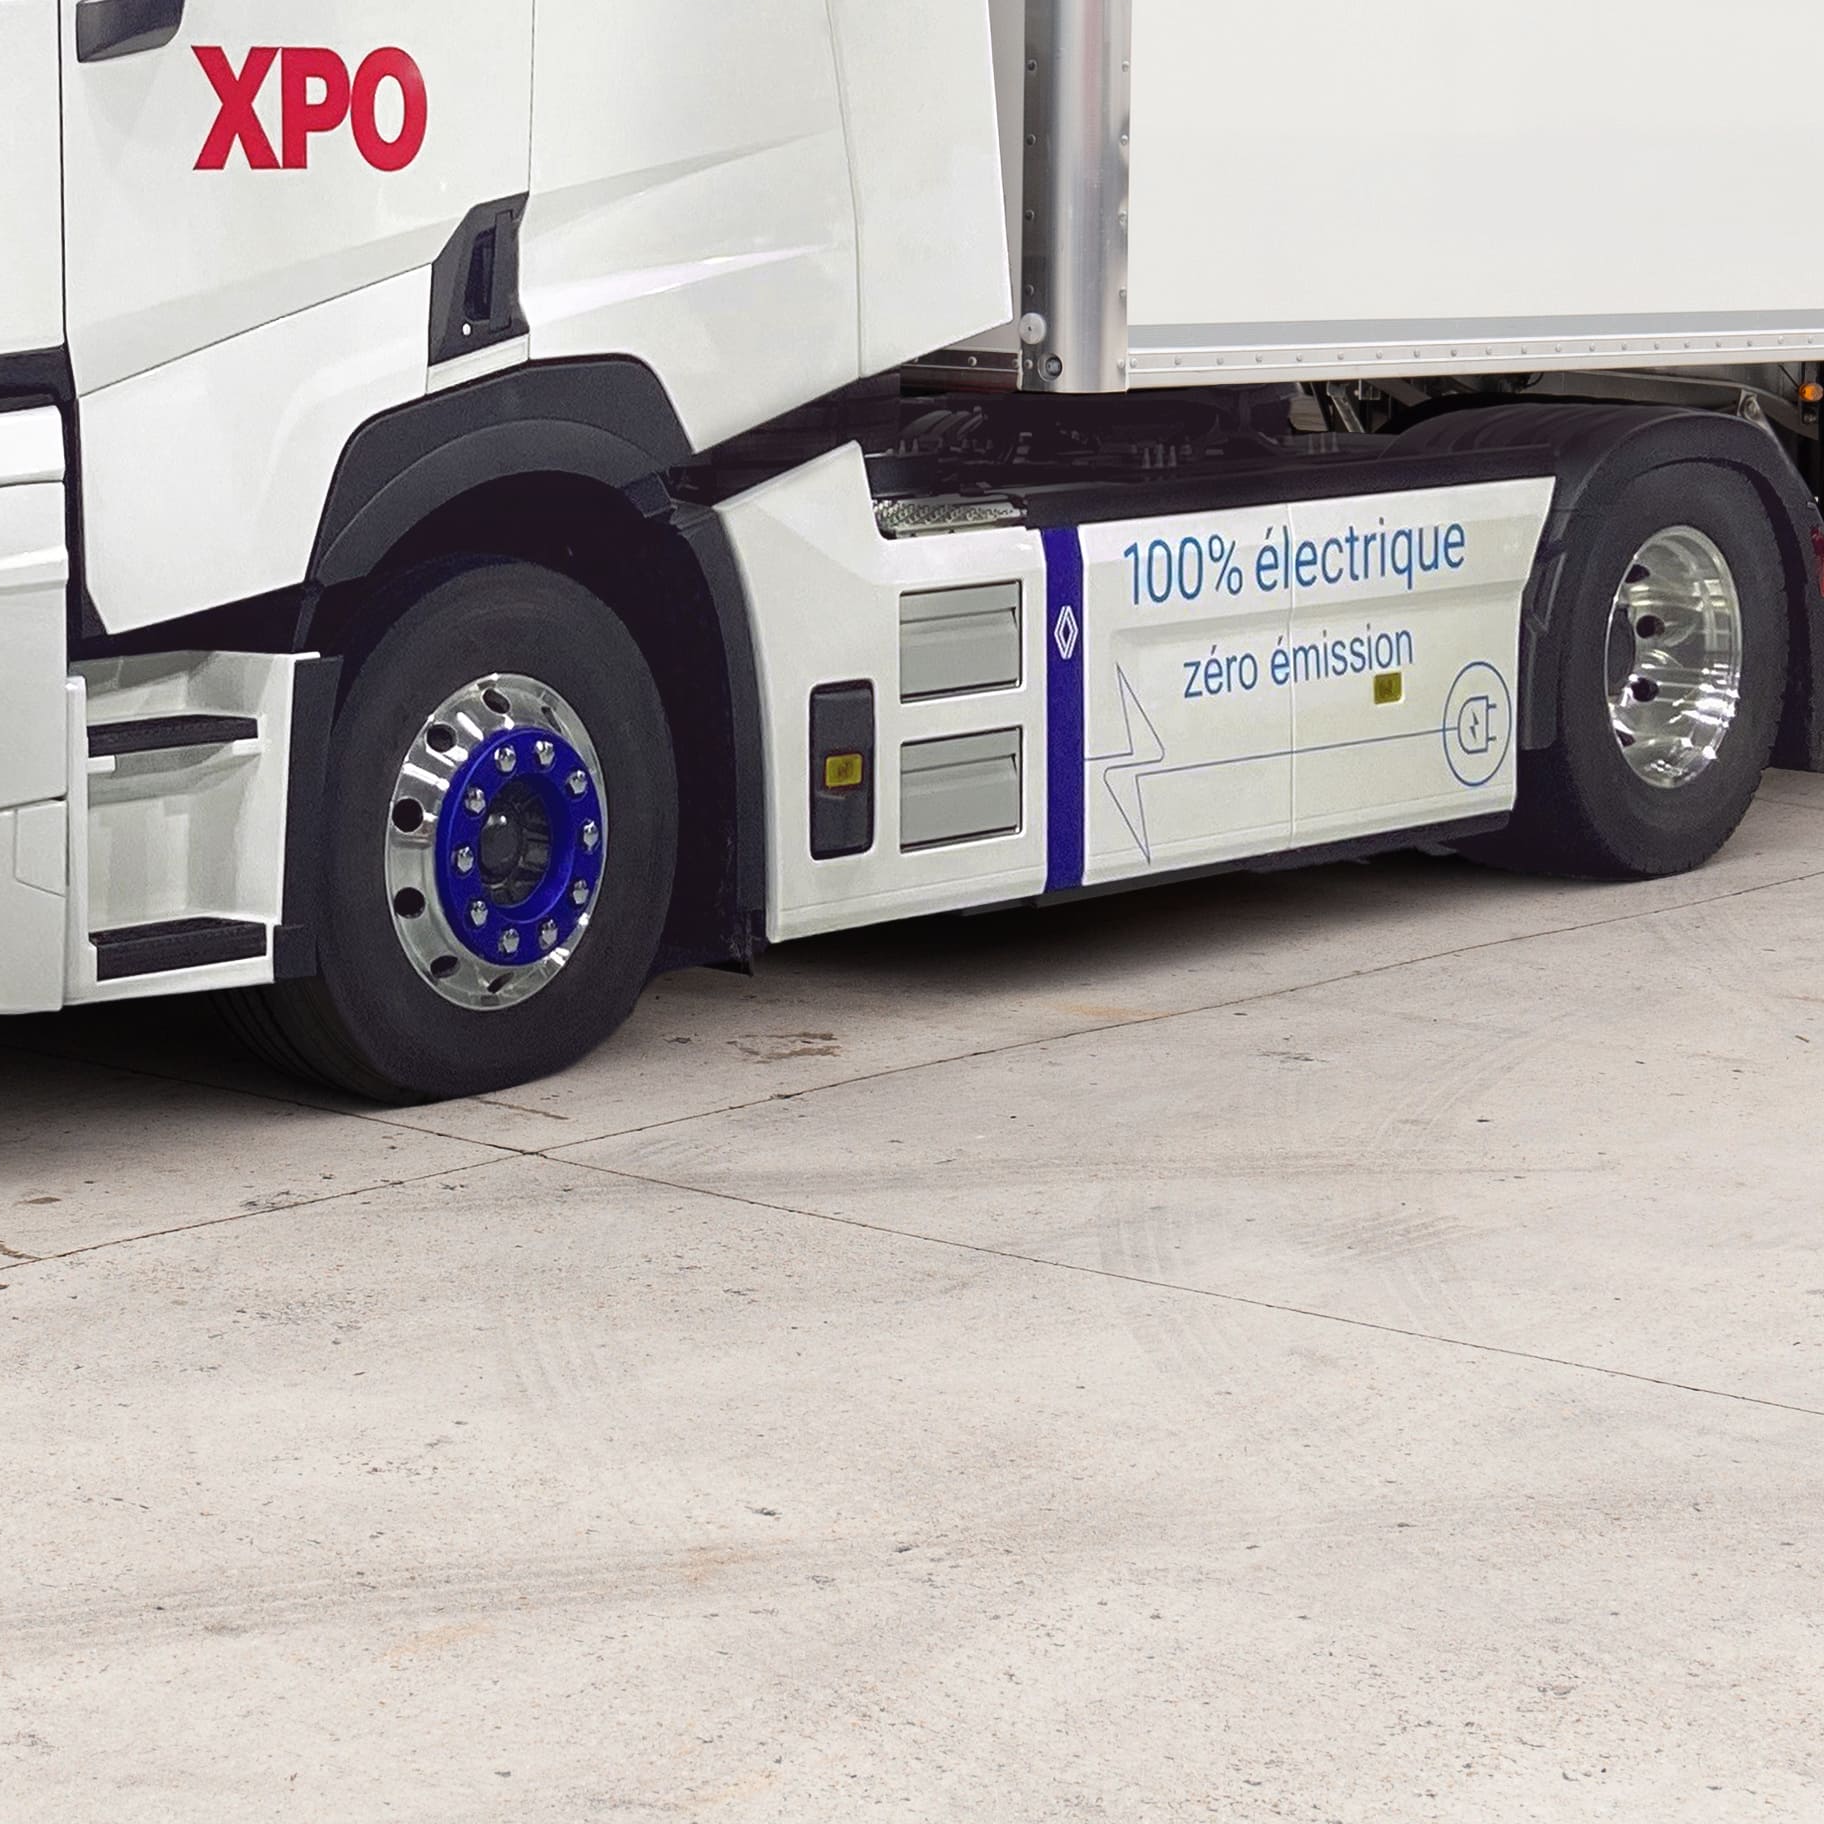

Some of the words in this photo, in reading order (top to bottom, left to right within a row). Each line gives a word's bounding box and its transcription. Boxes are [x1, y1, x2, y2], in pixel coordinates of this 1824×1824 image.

[191, 45, 427, 172] XPO
[1124, 534, 1243, 605] 100%
[1255, 517, 1466, 590] électrique
[1184, 645, 1258, 698] zéro
[1271, 623, 1413, 686] émission
